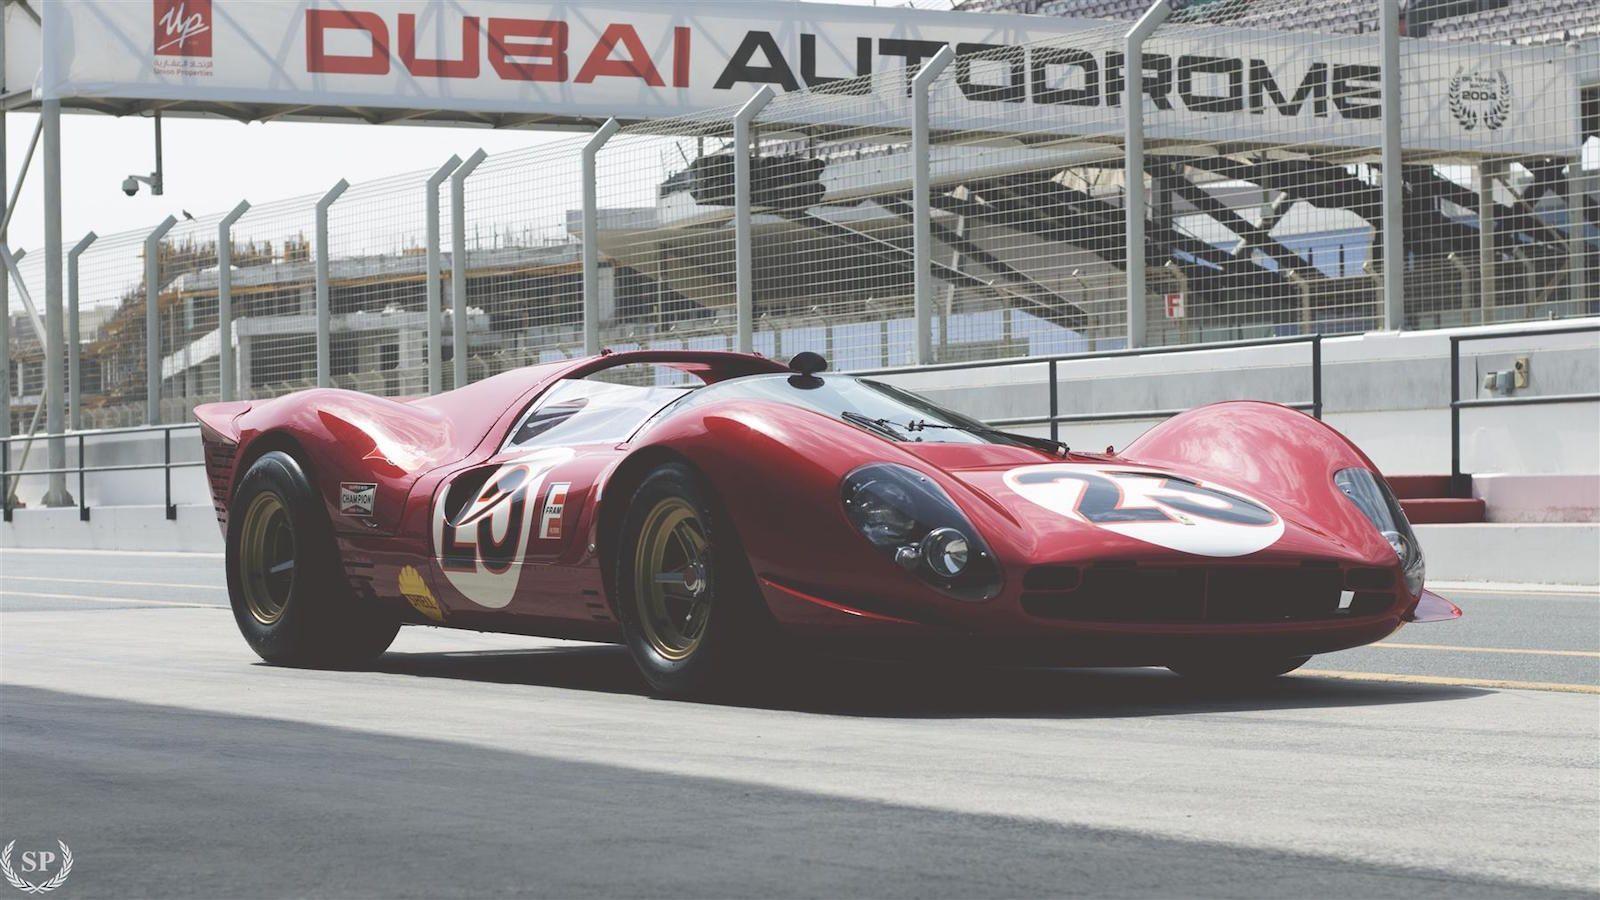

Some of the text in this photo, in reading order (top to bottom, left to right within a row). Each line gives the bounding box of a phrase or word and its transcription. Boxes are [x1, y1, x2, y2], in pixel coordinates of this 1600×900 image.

[306, 9, 1380, 120] DUBAI AUTODROME
[177, 69, 213, 77] Properties
[1462, 91, 1497, 100] 2004
[1167, 294, 1181, 317] F
[343, 494, 373, 504] CHAMPION
[546, 506, 562, 514] FRAM
